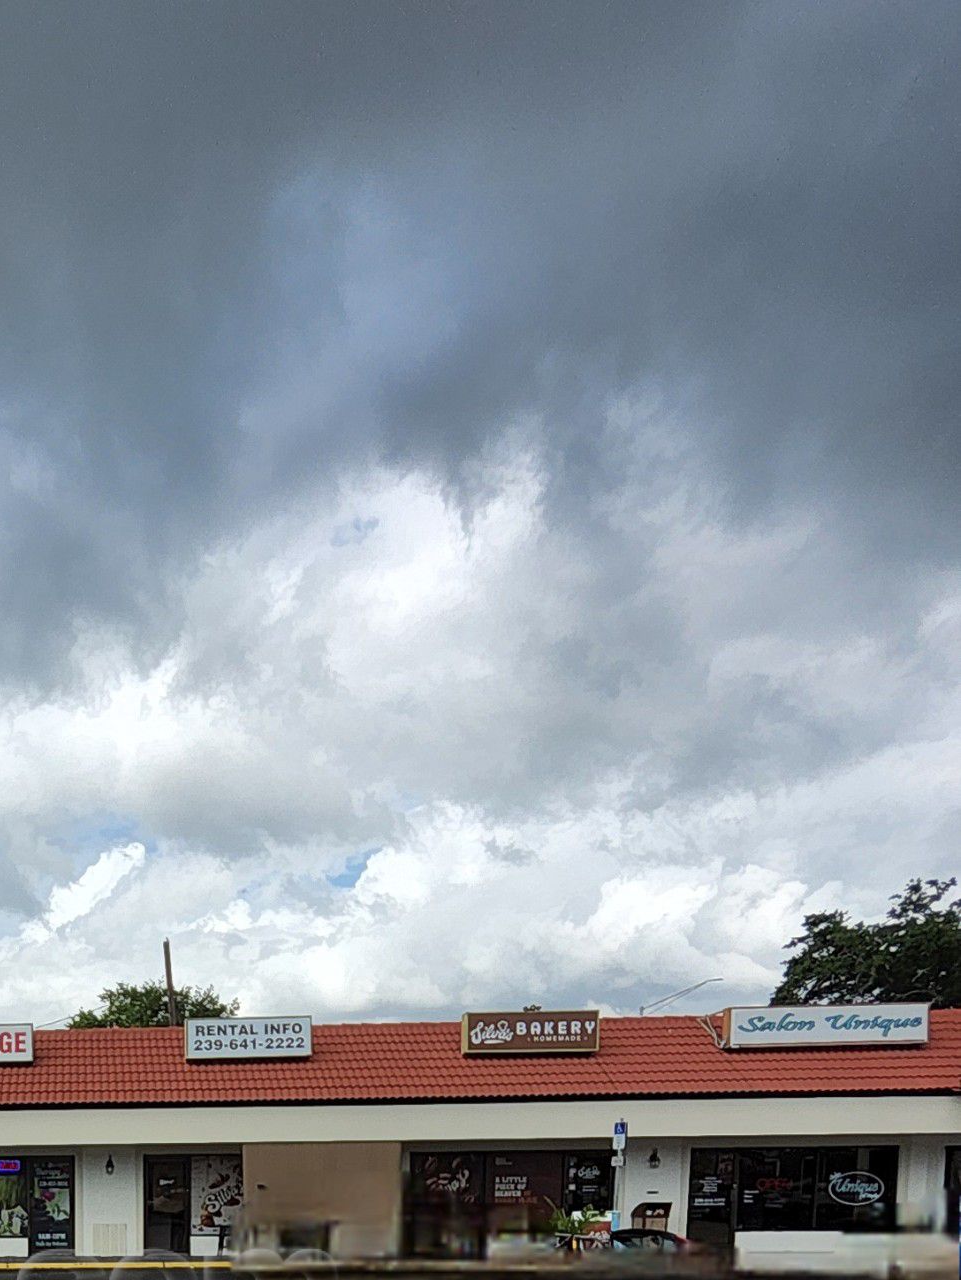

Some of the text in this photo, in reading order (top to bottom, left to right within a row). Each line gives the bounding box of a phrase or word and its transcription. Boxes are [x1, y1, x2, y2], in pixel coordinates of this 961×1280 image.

[194, 1022, 303, 1037] RENTAL INFO
[515, 1021, 596, 1036] BAKERY
[738, 1012, 924, 1037] Salon Unique
[193, 1037, 305, 1051] 239-641-2222
[834, 1178, 879, 1200] Unique
